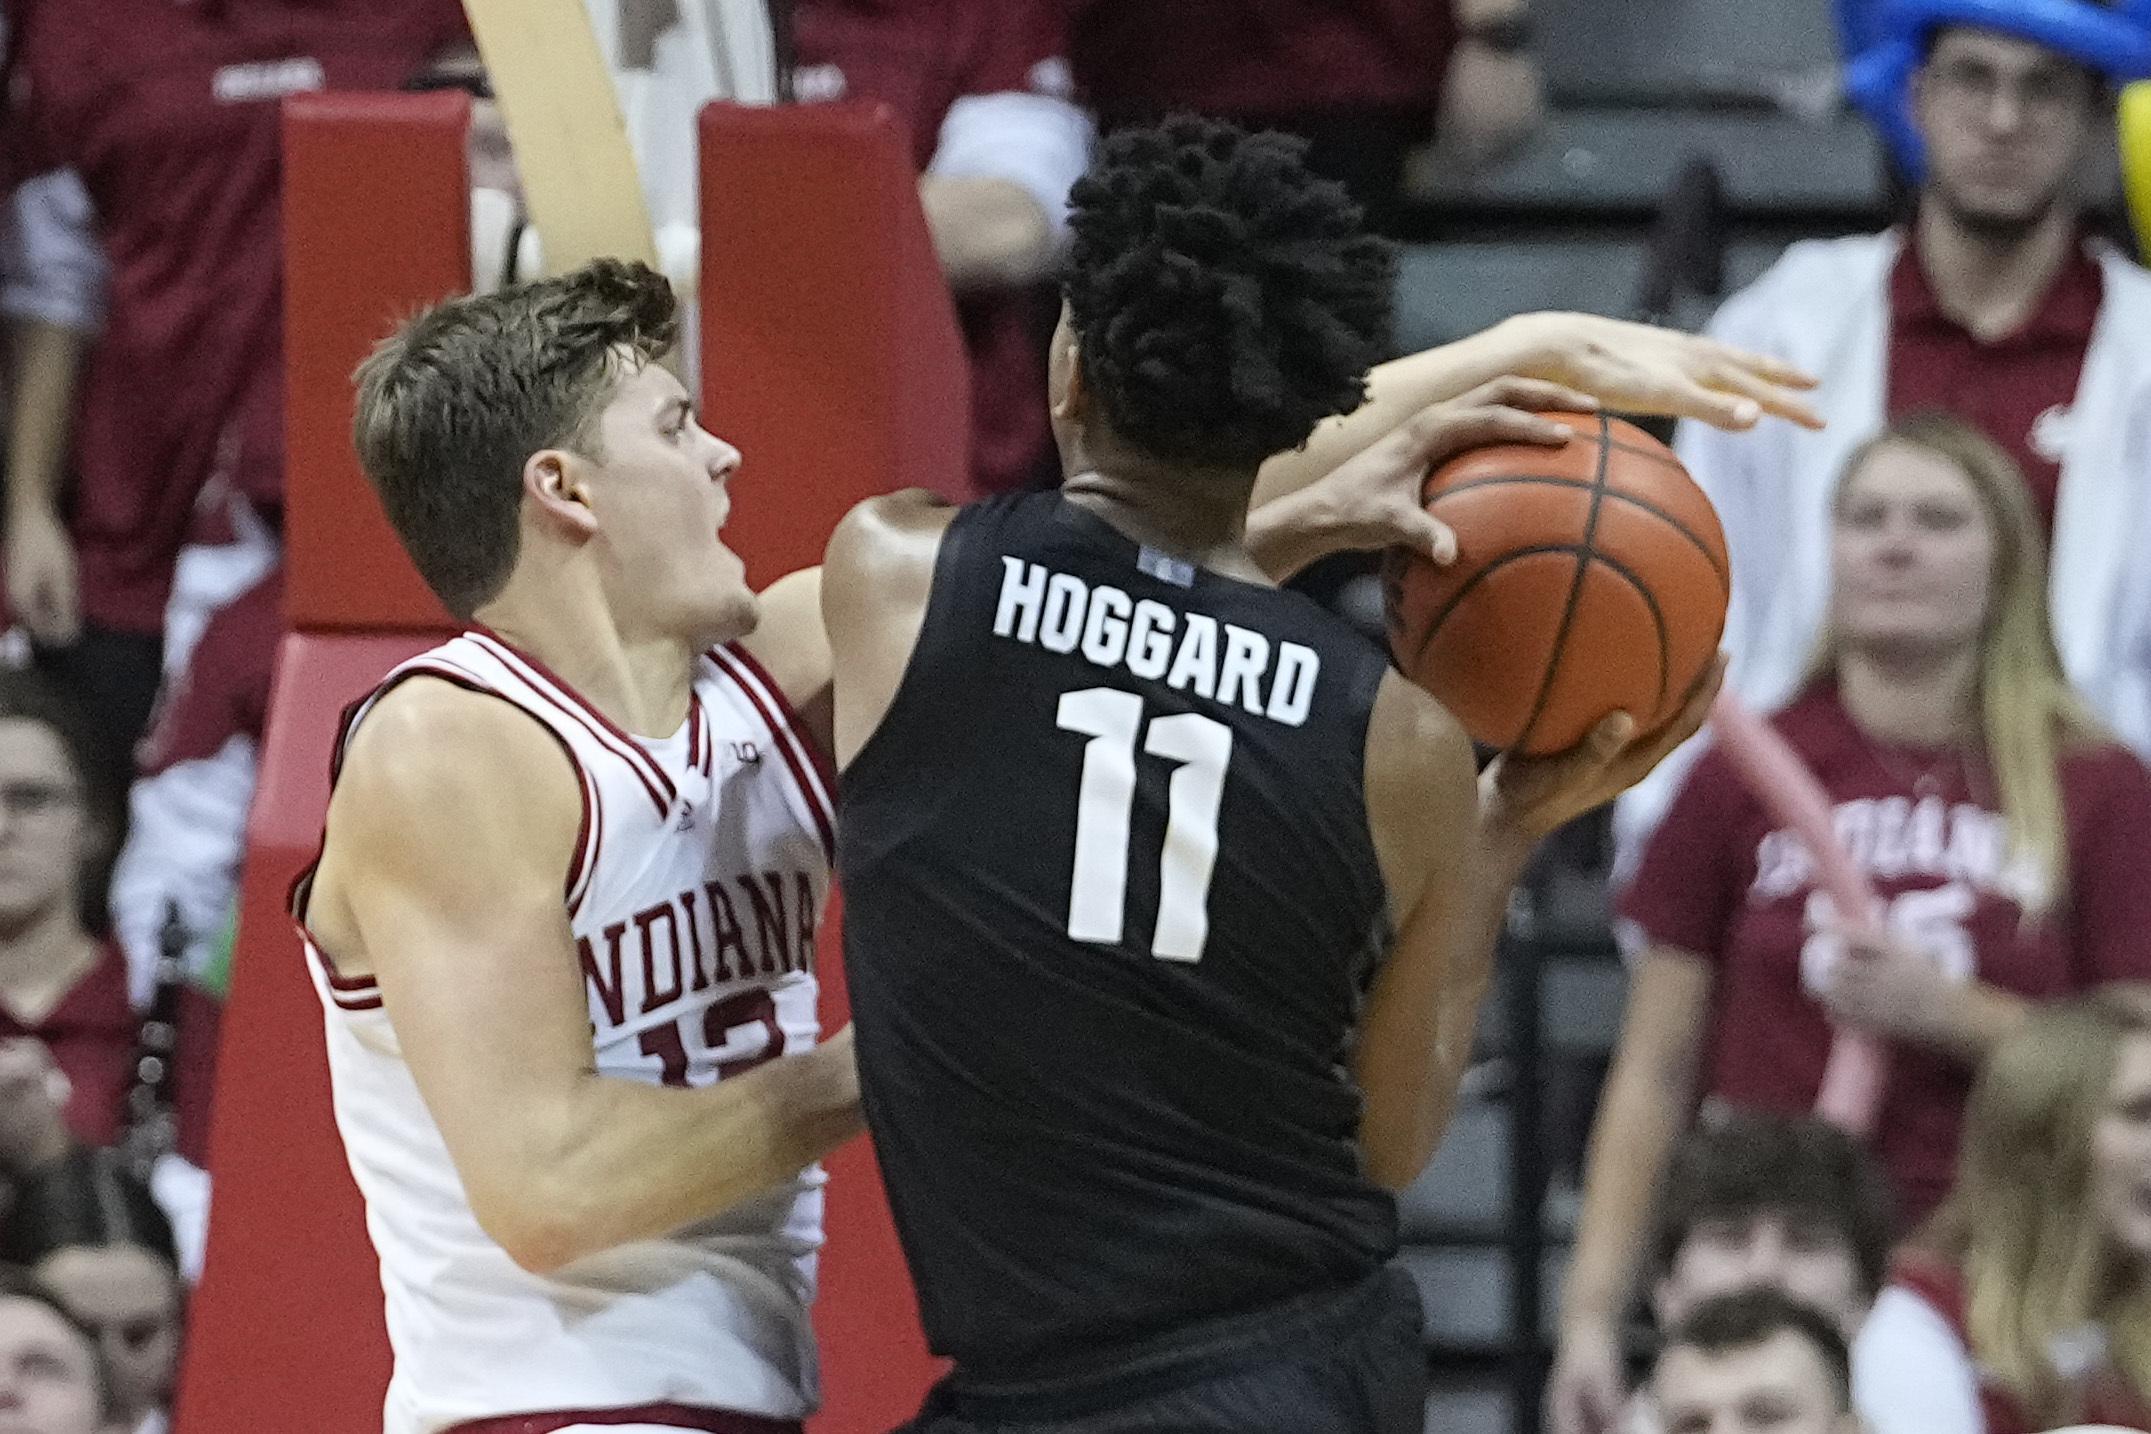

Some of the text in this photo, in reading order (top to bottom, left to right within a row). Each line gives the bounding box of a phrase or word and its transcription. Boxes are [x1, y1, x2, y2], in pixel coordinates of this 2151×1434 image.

[993, 555, 1321, 727] HOGGARD
[1056, 687, 1233, 963] 11
[577, 870, 816, 1027] NDIANA
